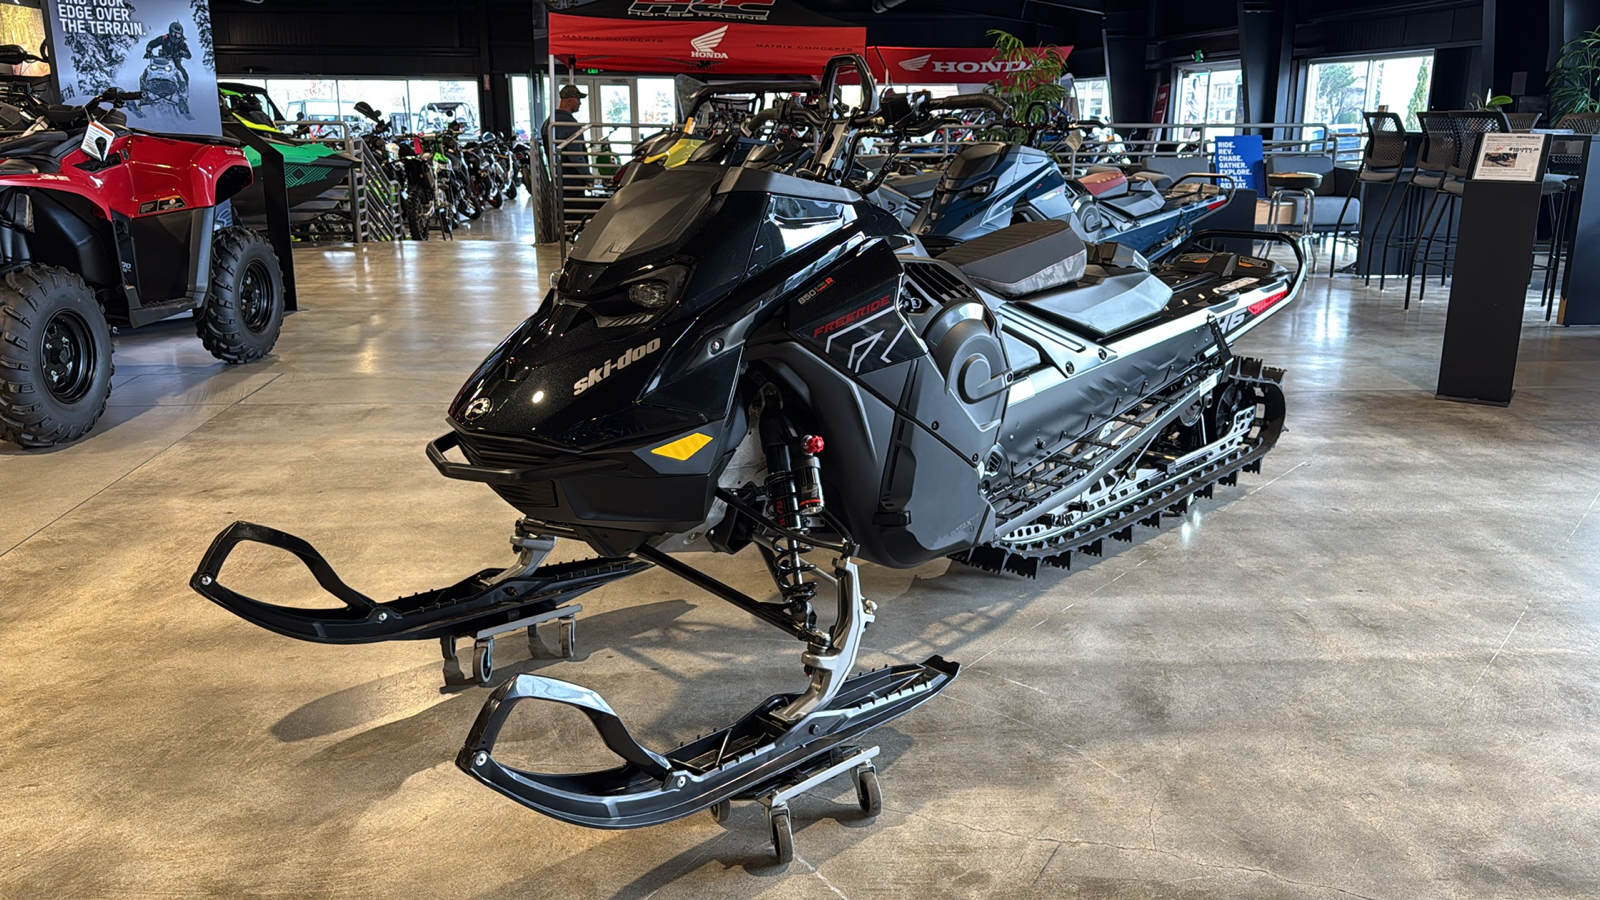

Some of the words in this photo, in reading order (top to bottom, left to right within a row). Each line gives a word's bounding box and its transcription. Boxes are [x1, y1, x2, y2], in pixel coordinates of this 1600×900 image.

[58, 4, 93, 20] EDGE
[96, 7, 130, 21] OVER
[59, 18, 86, 34] THE
[88, 21, 147, 36] TERRAIN.
[690, 51, 729, 59] HONDA
[798, 289, 817, 305] 850
[812, 294, 891, 339] FREERIDE
[573, 337, 661, 396] ski-doo
